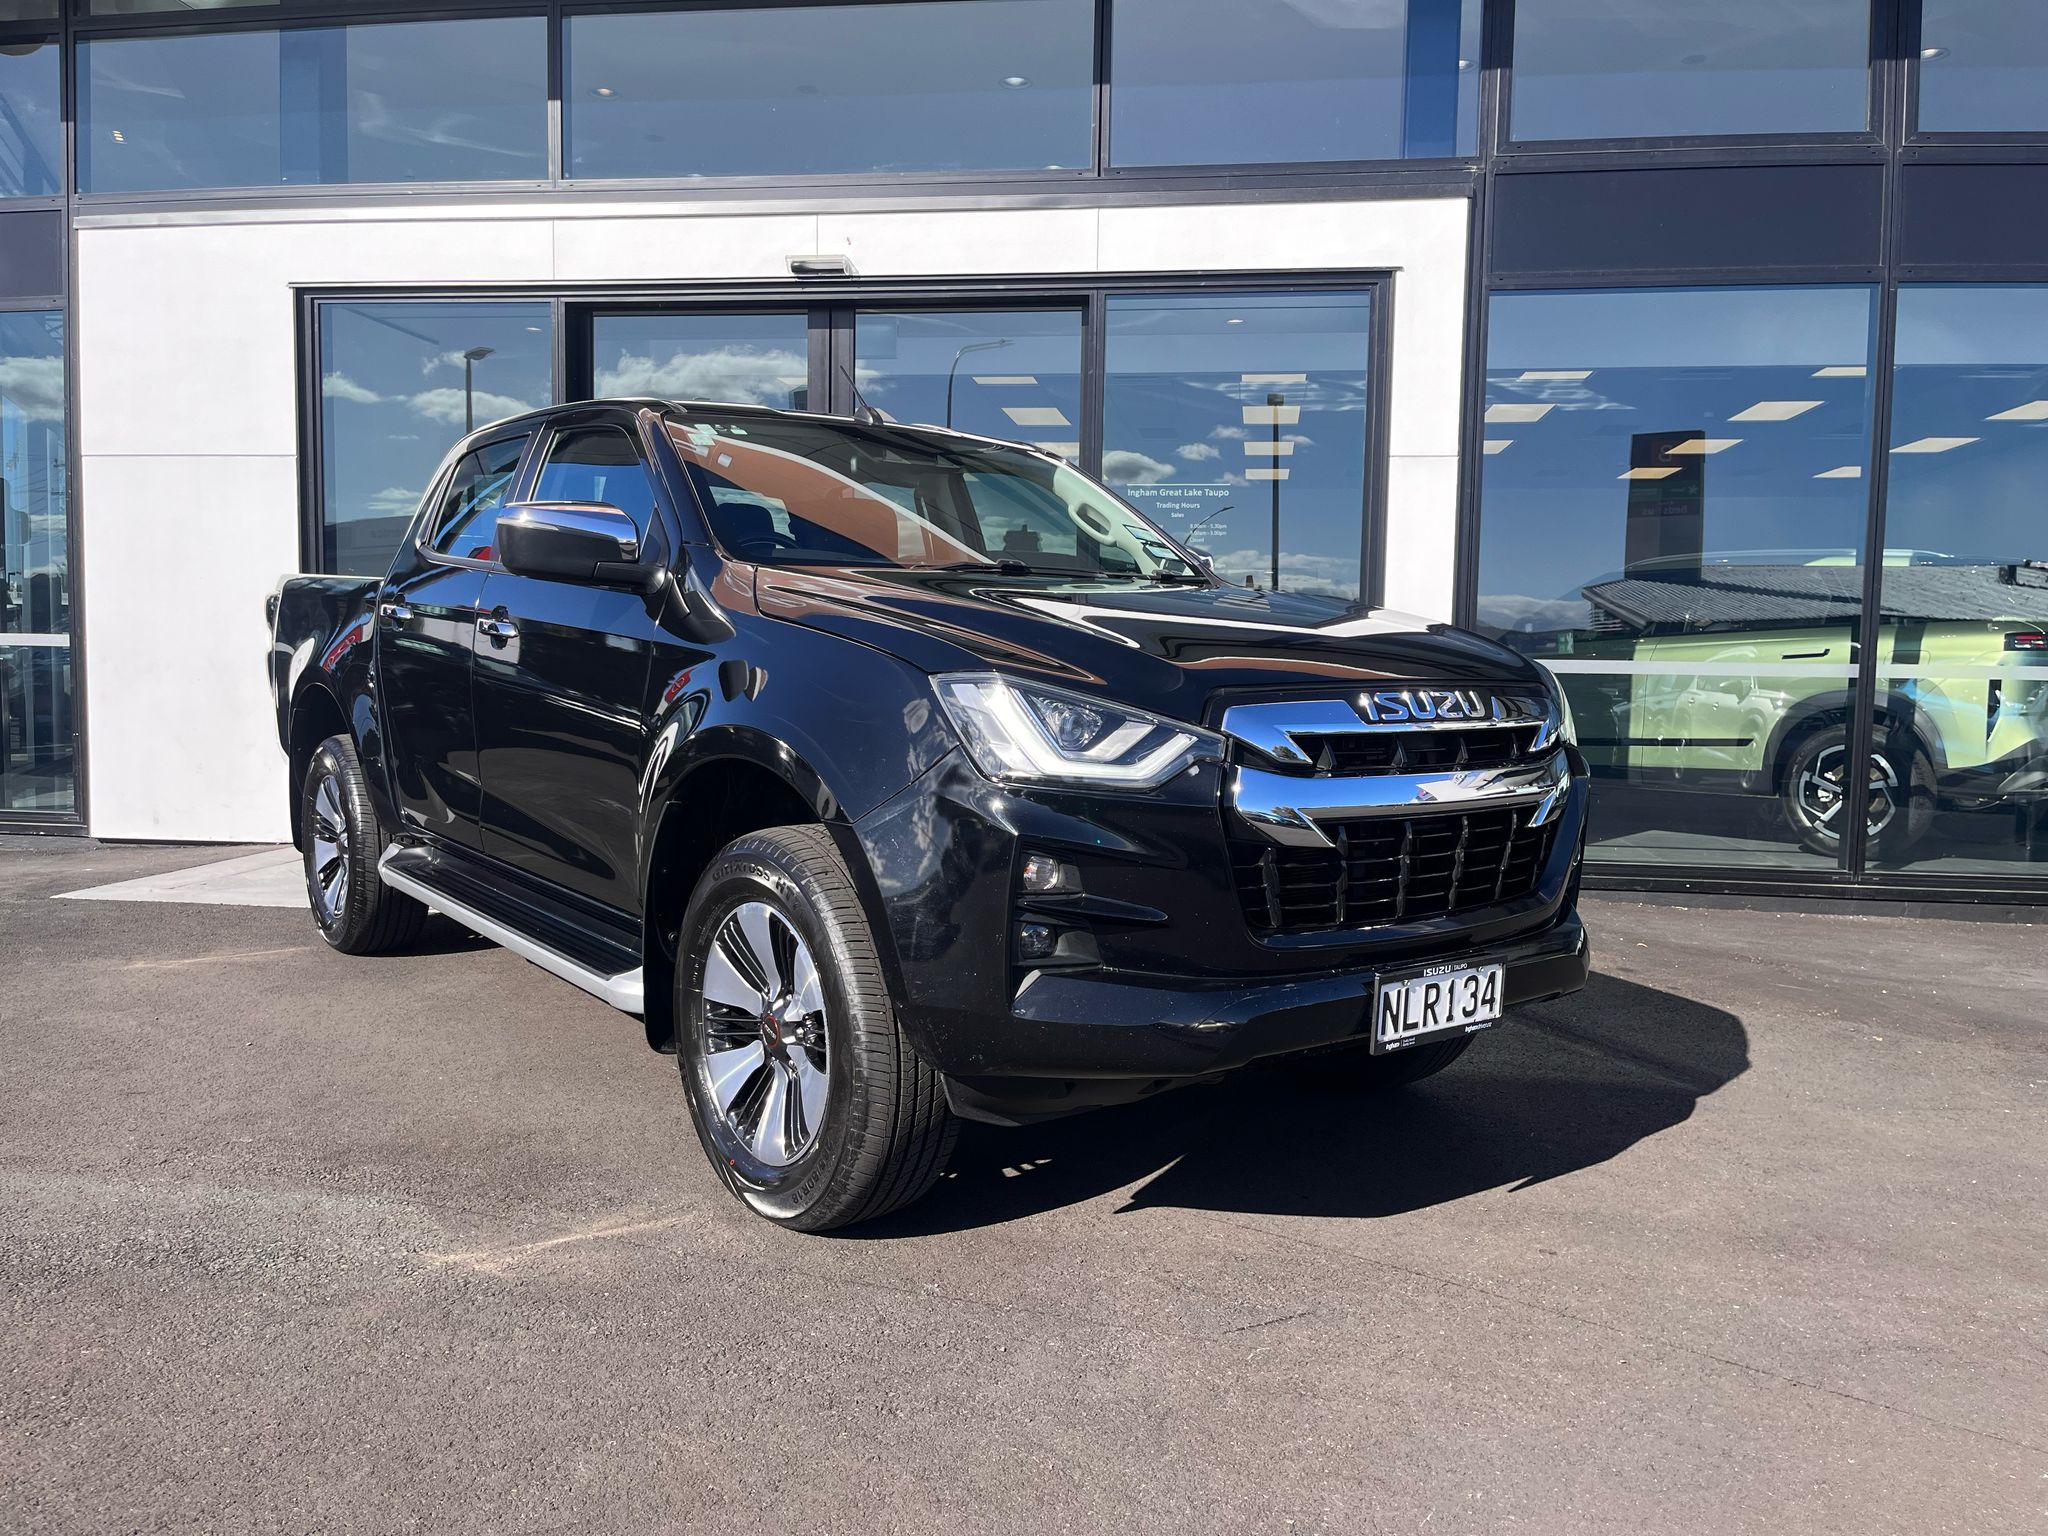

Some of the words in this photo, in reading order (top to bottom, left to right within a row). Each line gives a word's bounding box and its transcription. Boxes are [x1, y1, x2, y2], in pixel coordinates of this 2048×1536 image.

[1127, 488, 1158, 498] Ingham
[1160, 488, 1182, 497] Great
[1184, 488, 1202, 497] Lake
[1204, 488, 1230, 498] Taupo
[1359, 690, 1486, 721] ISUZU
[1423, 965, 1452, 977] ISUZU
[1381, 971, 1497, 1036] NLR134
